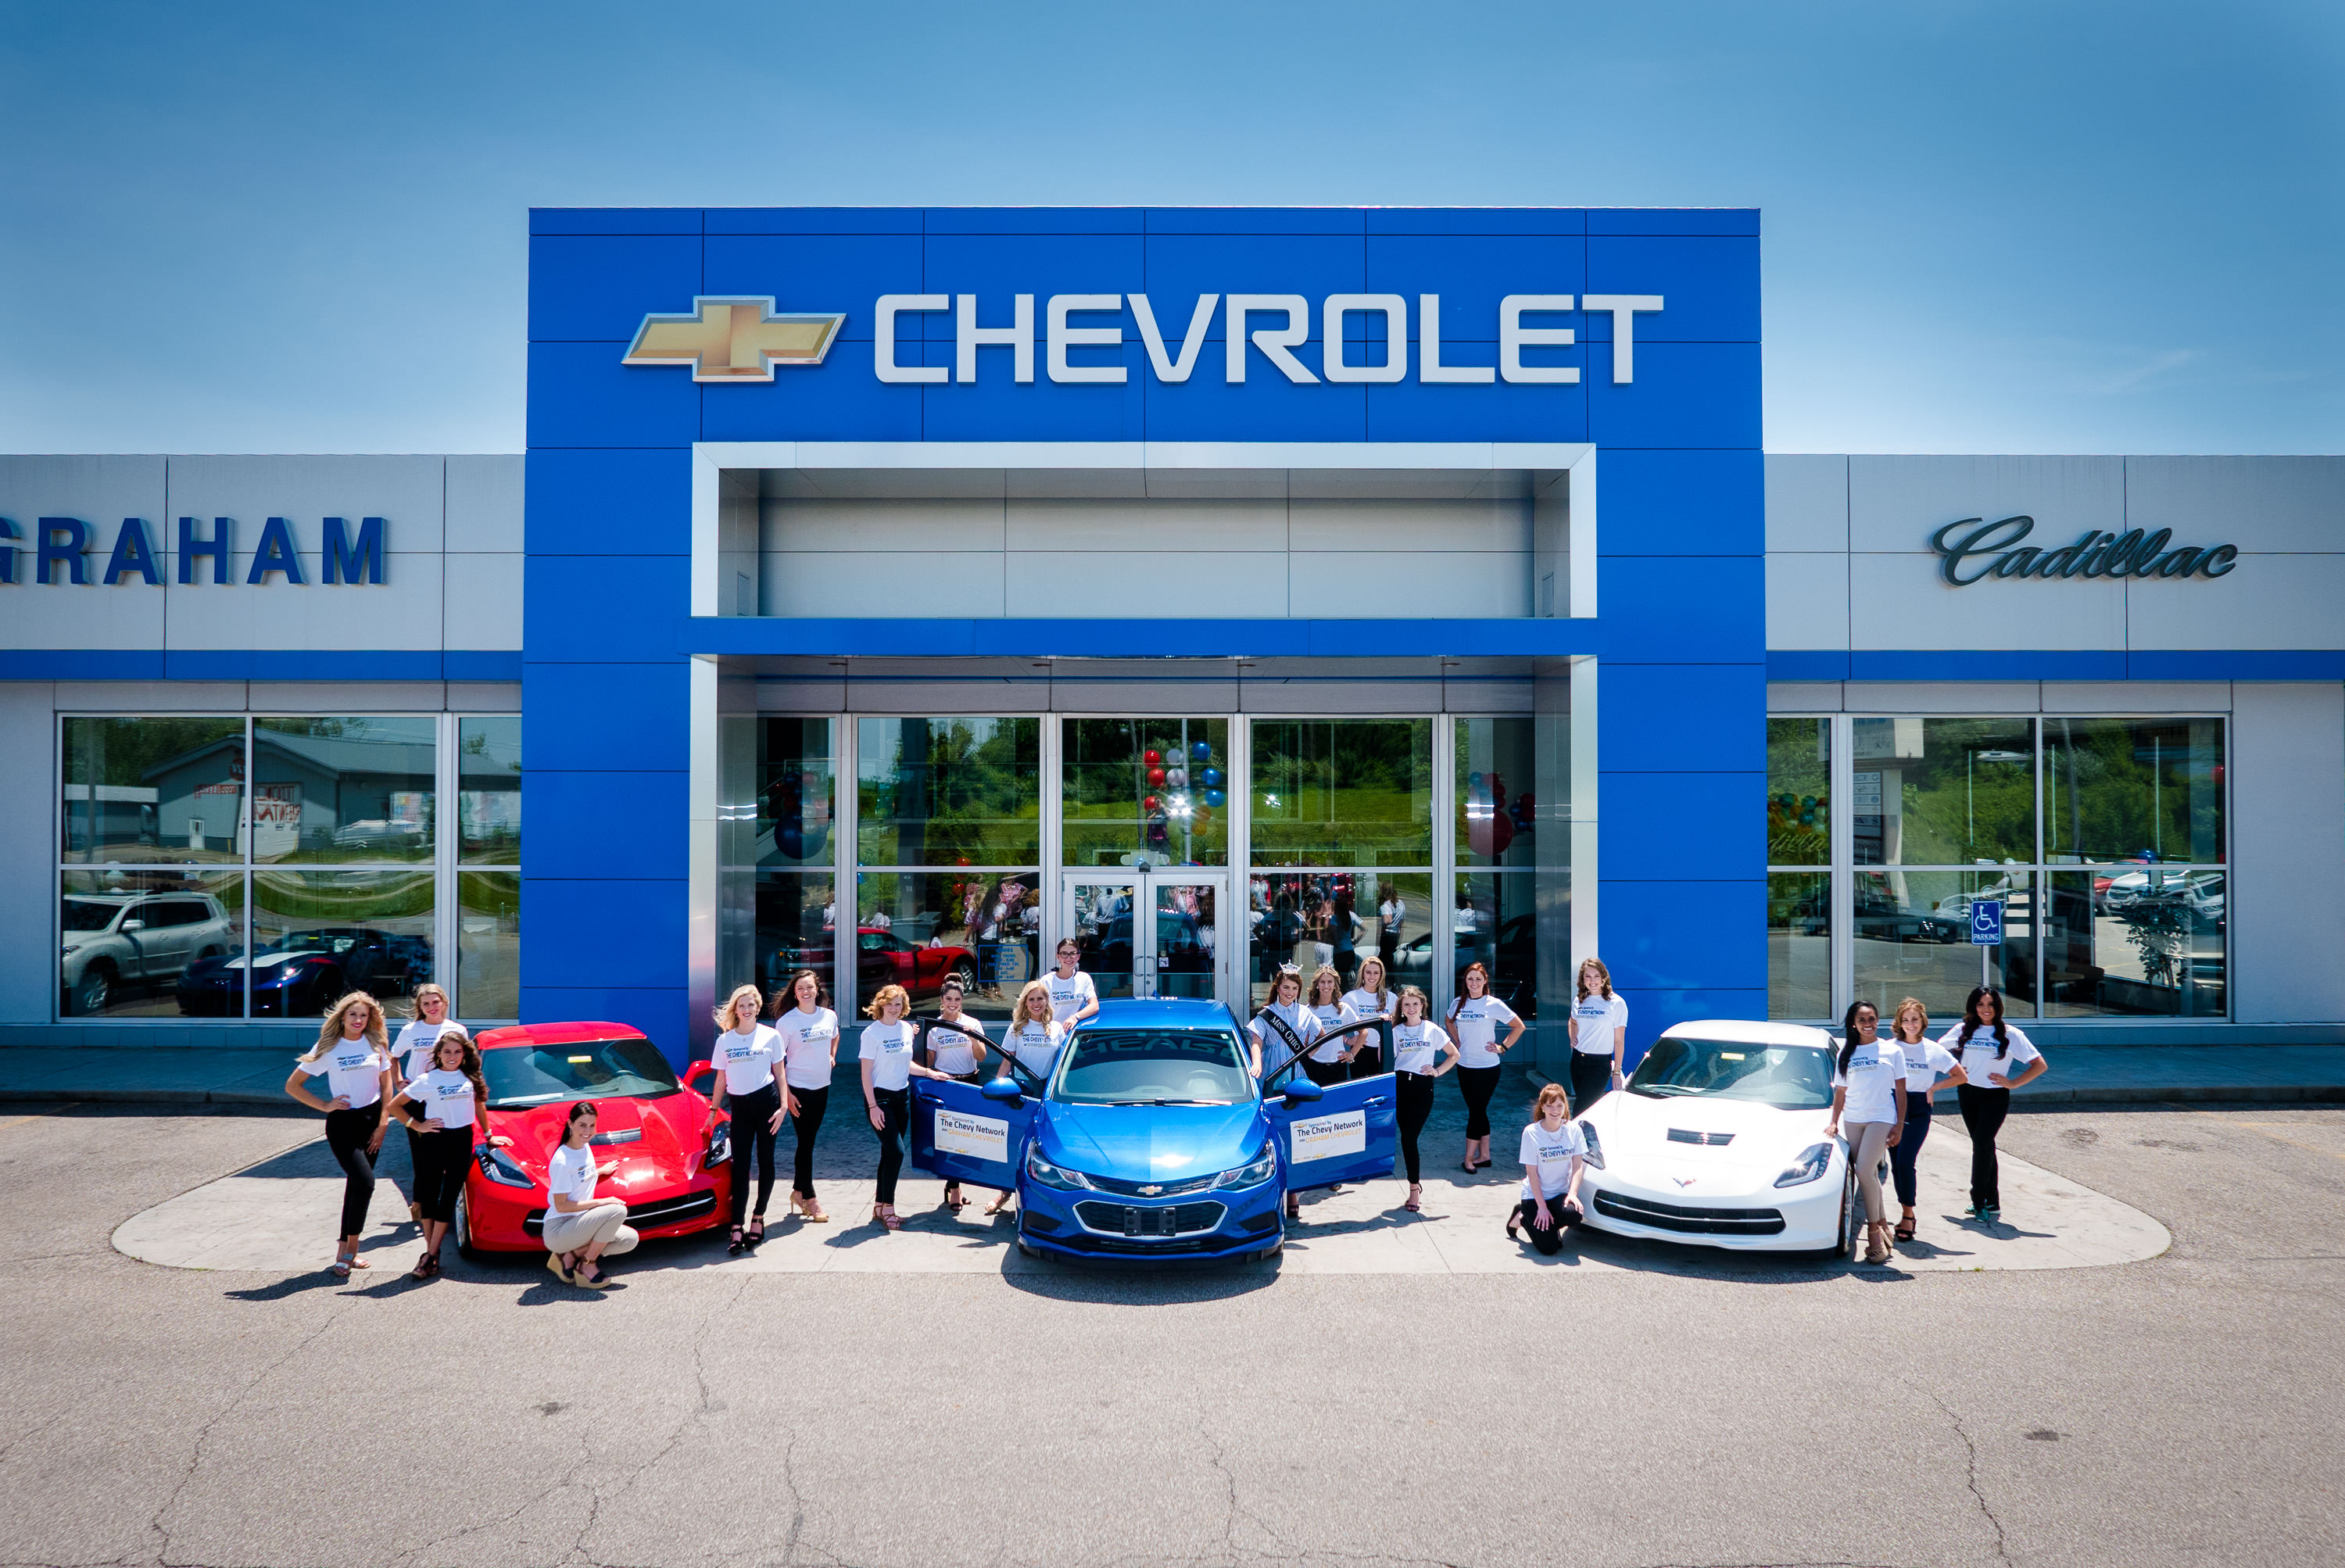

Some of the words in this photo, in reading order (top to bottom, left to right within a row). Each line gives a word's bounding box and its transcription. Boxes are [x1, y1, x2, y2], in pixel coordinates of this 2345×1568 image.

[874, 293, 1664, 385] CHEVROLET
[1931, 515, 2238, 586] Cadillac
[1270, 1016, 1287, 1032] MISS
[1285, 1030, 1301, 1051] OHIO
[940, 1118, 953, 1127] The
[954, 1121, 975, 1133] Chevy
[976, 1125, 1005, 1137] Network
[1312, 1126, 1333, 1134] Chevy
[1334, 1119, 1363, 1131] Network
[1330, 1128, 1362, 1139] CHEVROLET
[948, 1129, 971, 1139] GRAHAM
[972, 1133, 1003, 1144] CHEVROLET
